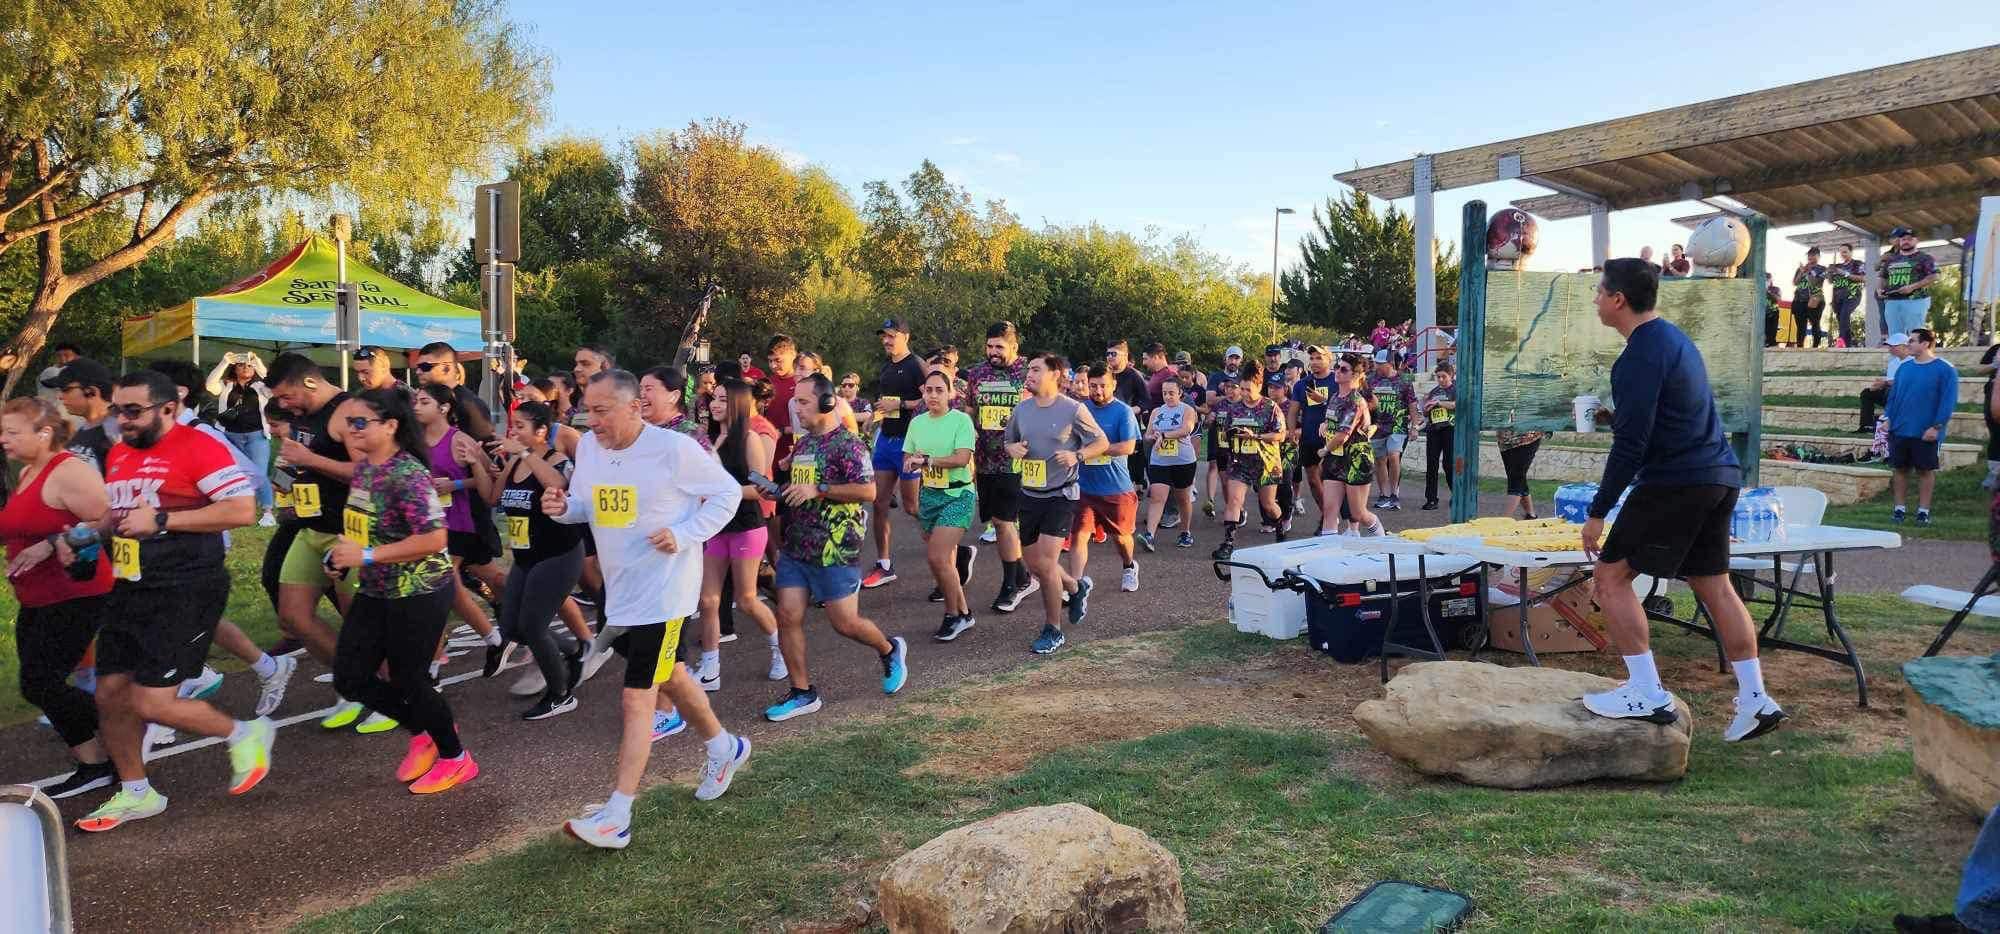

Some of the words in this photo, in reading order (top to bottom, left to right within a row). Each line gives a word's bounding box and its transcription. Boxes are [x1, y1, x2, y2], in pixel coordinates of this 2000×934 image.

[290, 278, 381, 293] Sanía
[282, 290, 409, 308] SENRIAL
[976, 393, 1019, 405] ZOMBIE
[105, 478, 165, 509] OCK
[599, 488, 629, 512] 635
